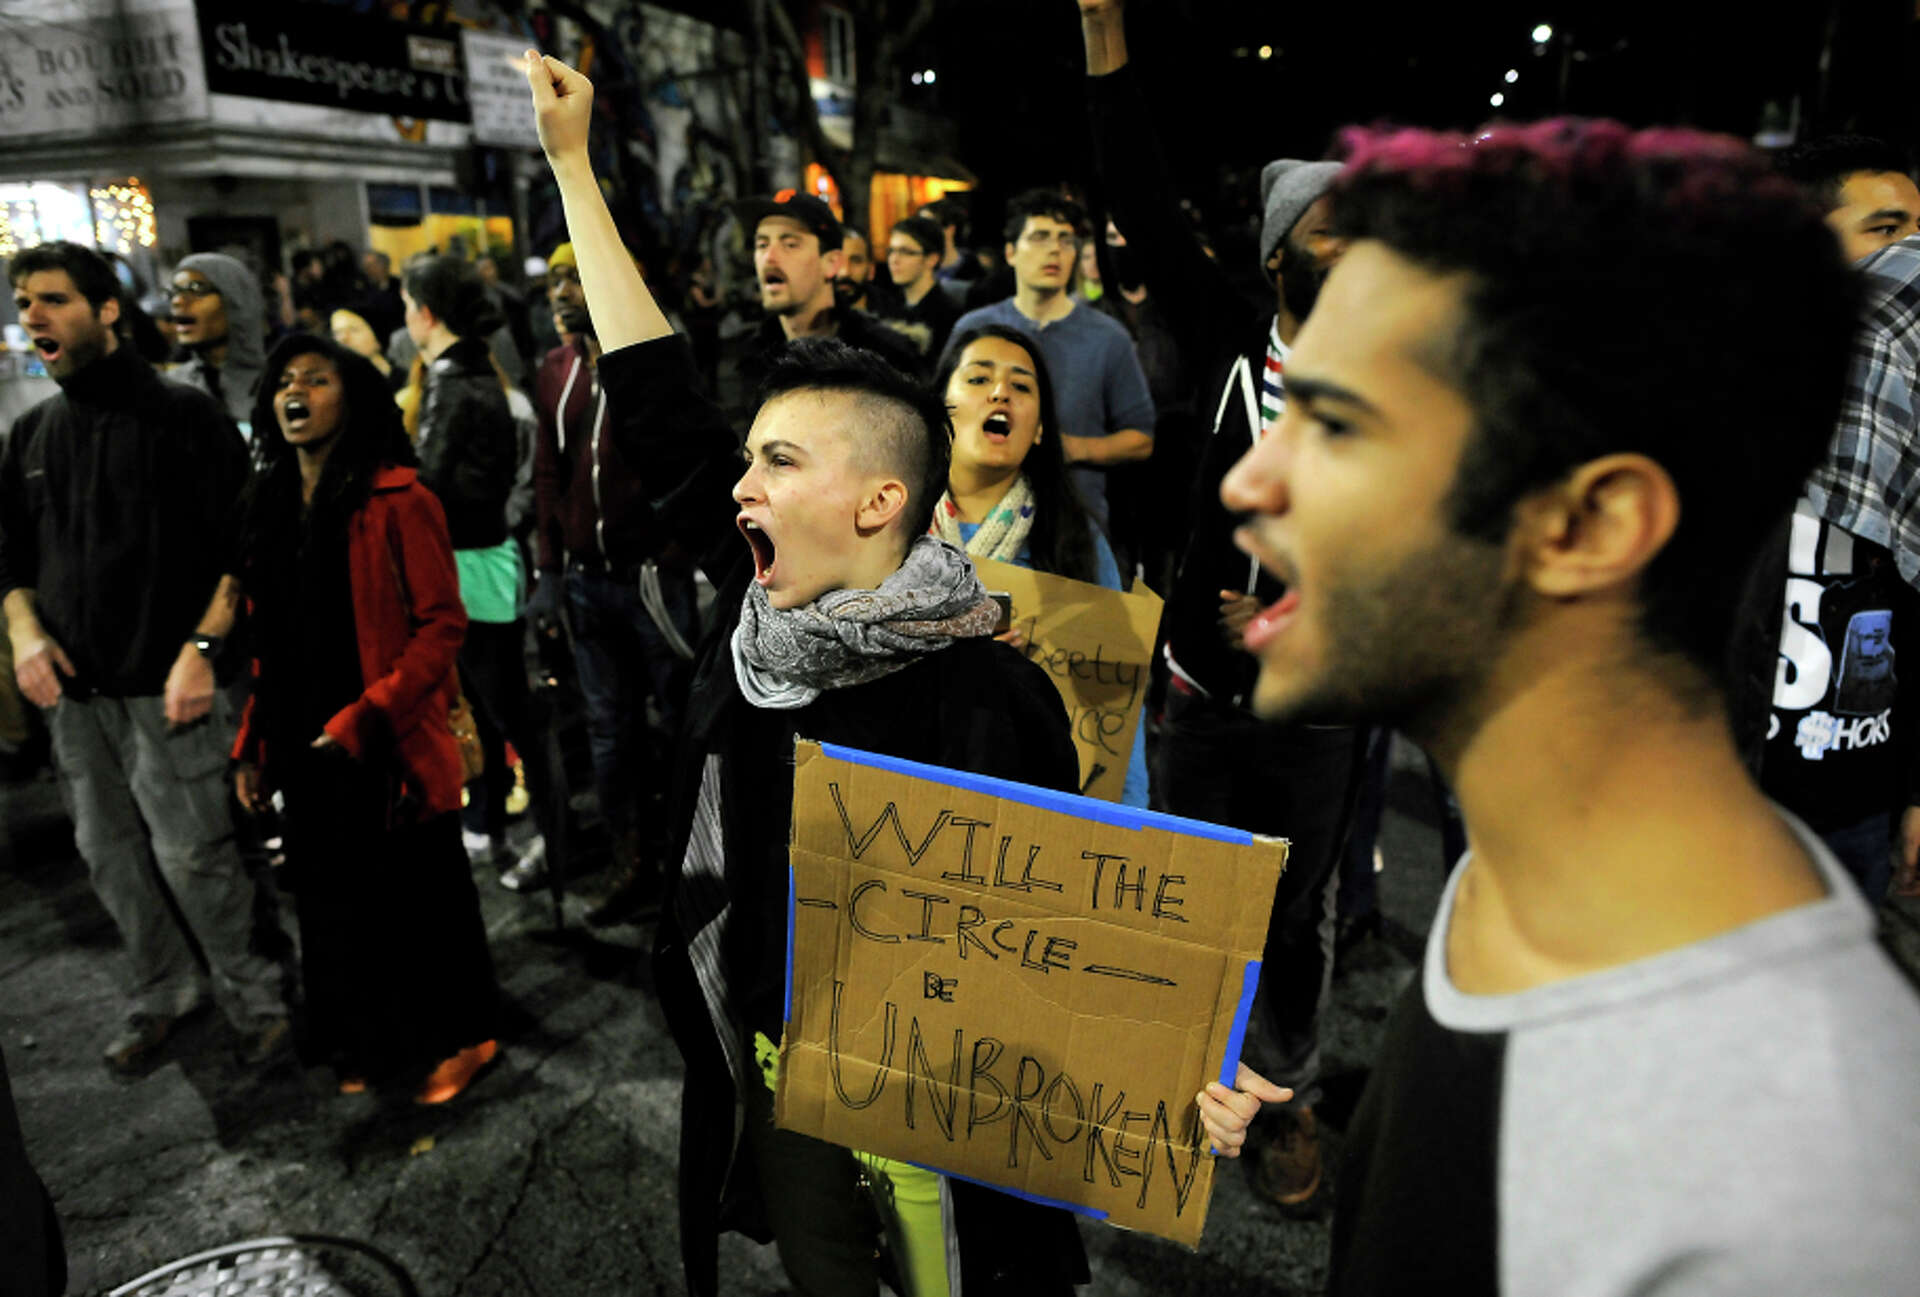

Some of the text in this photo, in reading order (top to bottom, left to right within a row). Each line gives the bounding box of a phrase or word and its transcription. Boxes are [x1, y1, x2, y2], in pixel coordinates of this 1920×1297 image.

[829, 782, 1189, 922] WILL THE
[923, 970, 959, 1002] BE
[828, 980, 1201, 1218] UNBROKEN
